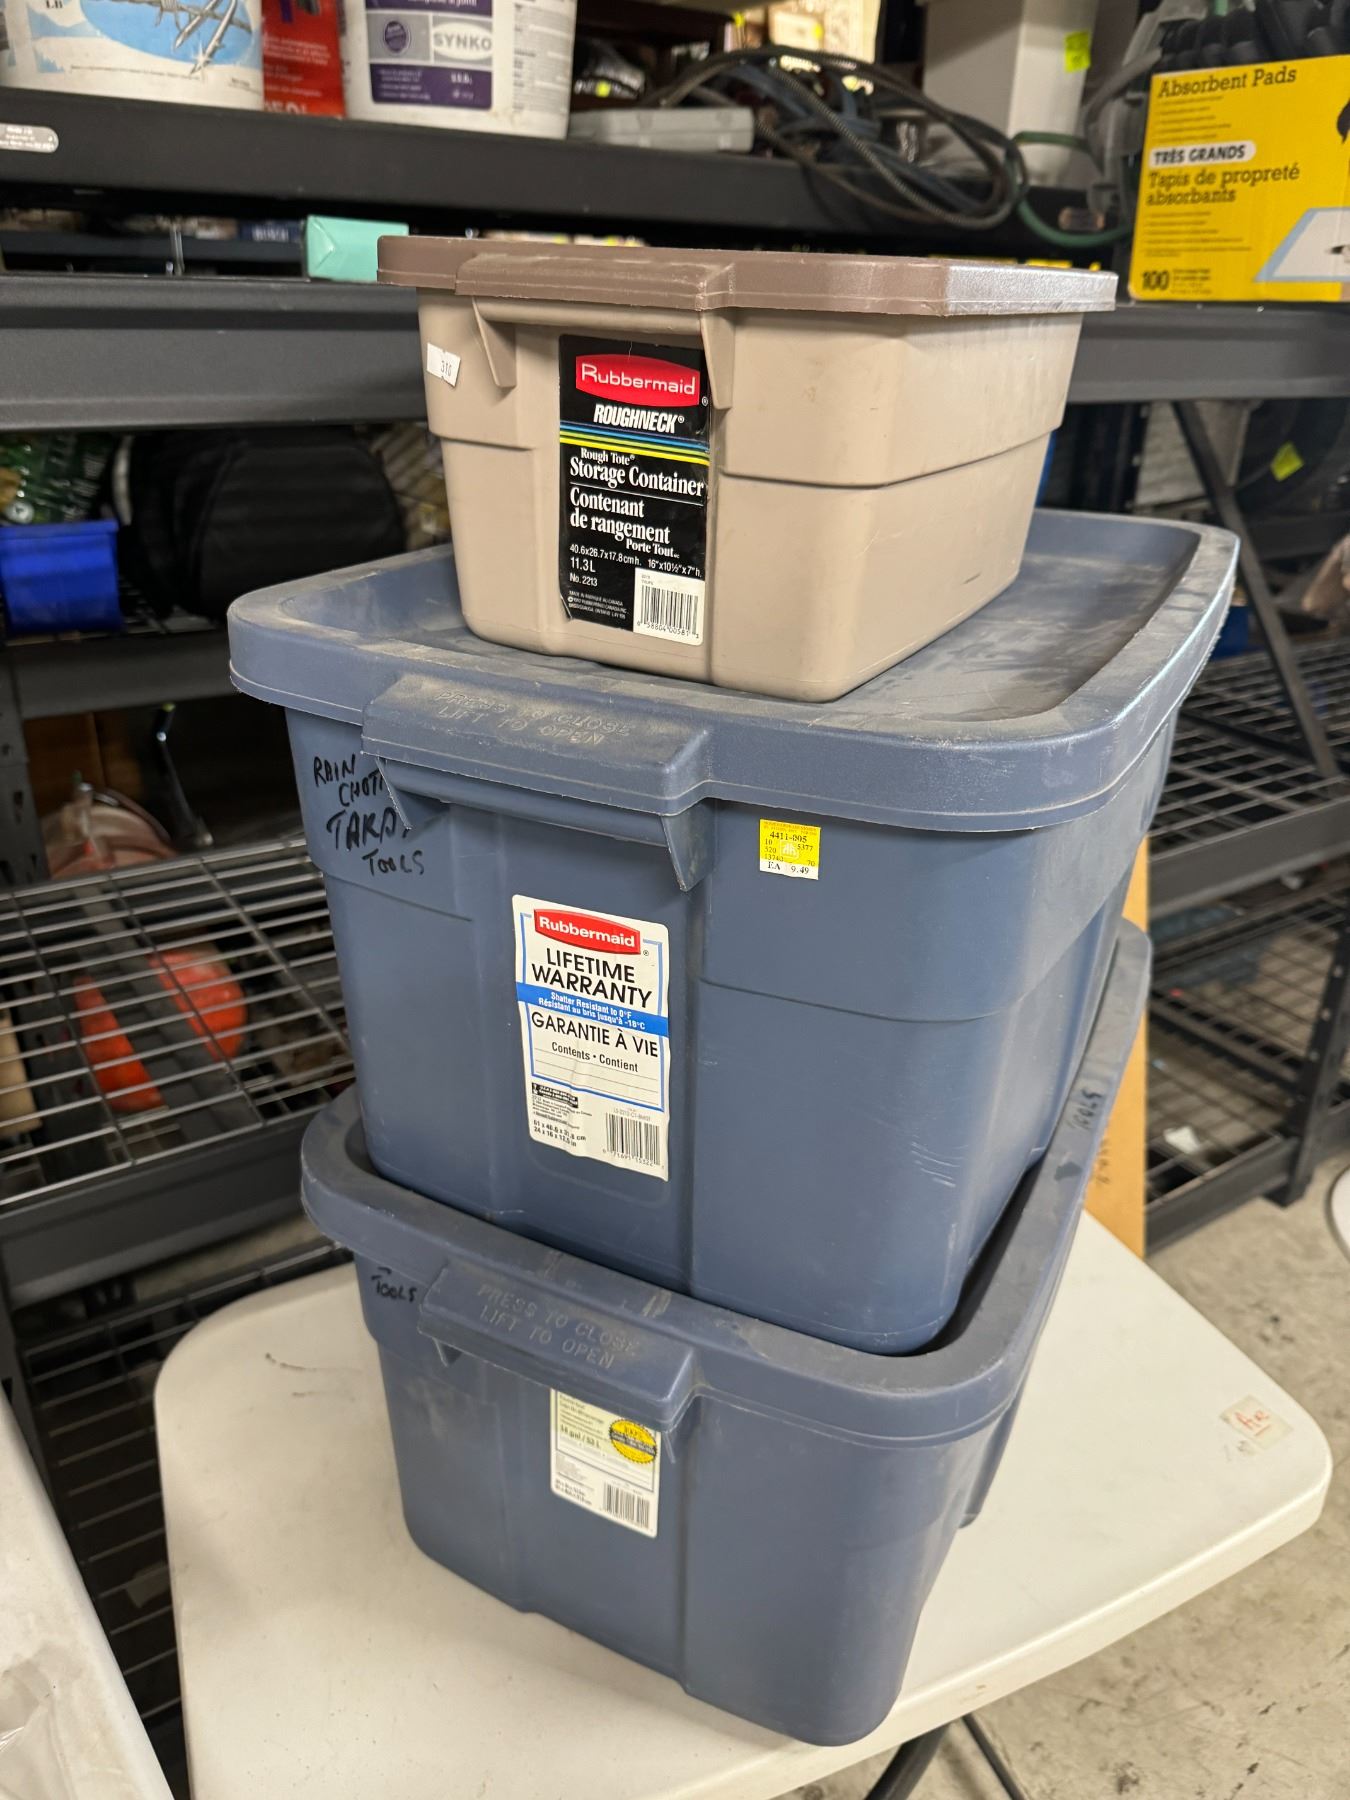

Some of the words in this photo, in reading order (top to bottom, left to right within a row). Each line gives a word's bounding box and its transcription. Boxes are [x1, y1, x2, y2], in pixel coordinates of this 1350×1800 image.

[433, 32, 492, 50] SYNKO
[1158, 74, 1247, 98] Absorbent
[1252, 66, 1297, 87] Pads
[1189, 145, 1246, 161] GRANDS
[1149, 169, 1190, 191] Tapis
[1195, 168, 1216, 185] de
[1222, 162, 1300, 188] propreté
[1146, 188, 1236, 206] absorbants
[581, 363, 696, 395] Rubbermaid
[581, 447, 609, 464] Rough
[570, 456, 626, 489] Storage
[628, 466, 704, 496] Container
[570, 487, 645, 518] Contenant
[570, 507, 588, 529] de
[591, 516, 671, 545] rangement
[626, 538, 652, 553] Porte
[582, 576, 598, 587] 2213
[313, 753, 356, 788] RAIN
[790, 865, 809, 874] 9.49
[540, 916, 635, 947] Rubbermaid
[547, 947, 635, 983] LIFETIME
[532, 963, 652, 1008] WARRANTY
[572, 1006, 581, 1014] au
[582, 1008, 596, 1018] bris
[576, 998, 609, 1014] Resistant
[610, 1004, 617, 1016] to
[532, 1011, 610, 1046] GARANTIE
[615, 1029, 628, 1051] À
[632, 1035, 659, 1058] VIE
[552, 1041, 590, 1060] Contents
[600, 1054, 639, 1072] Contient
[371, 1275, 417, 1302] TOOLS
[480, 1304, 518, 1332] LIFT
[528, 1326, 552, 1345] TO
[561, 1337, 615, 1370] OPEN
